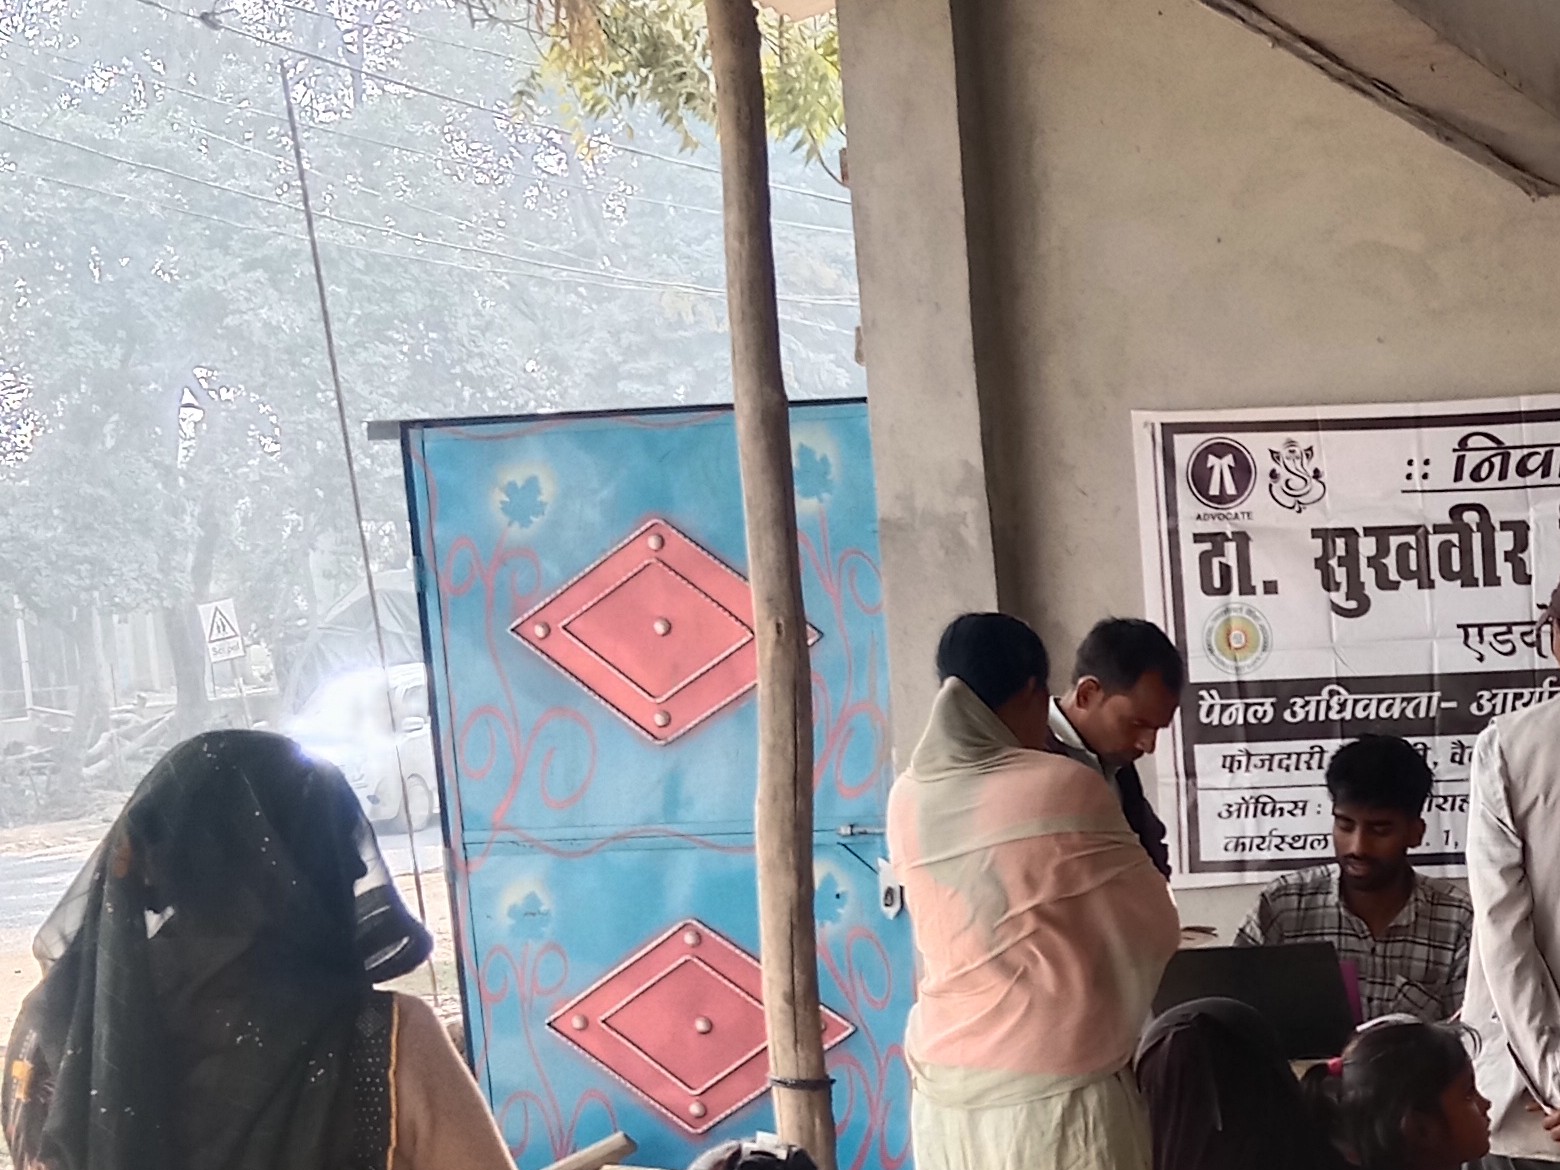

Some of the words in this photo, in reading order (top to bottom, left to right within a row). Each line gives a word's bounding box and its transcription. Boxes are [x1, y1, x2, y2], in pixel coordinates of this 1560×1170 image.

[1195, 510, 1254, 522] ADVOCATE
[1192, 530, 1279, 597] ठा.
[1310, 502, 1533, 619] सुखवीर
[1197, 689, 1278, 727] पैनल
[1220, 744, 1329, 775] फौजदारी
[1222, 827, 1333, 855] कार्यस्थल
